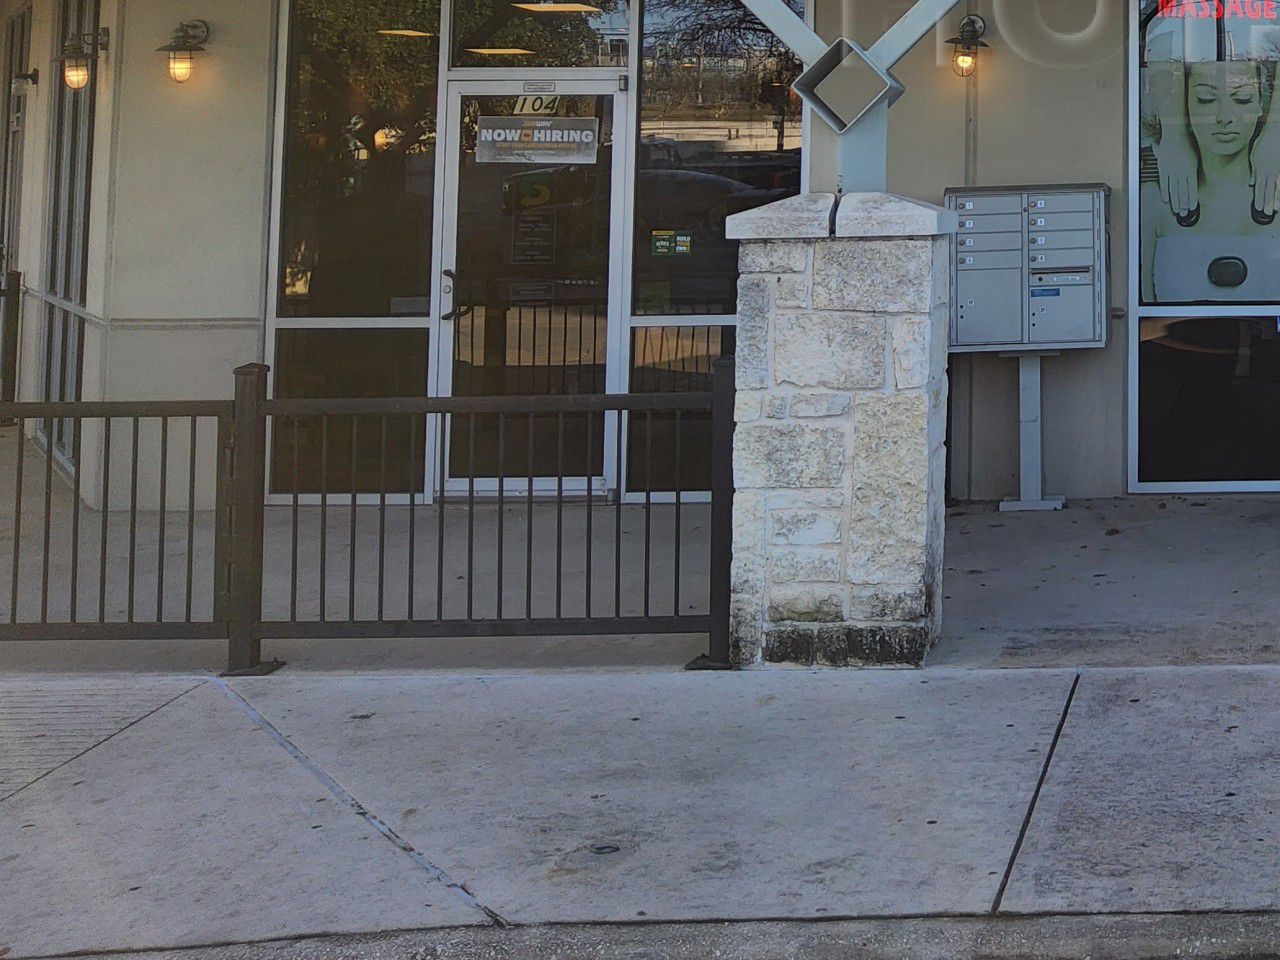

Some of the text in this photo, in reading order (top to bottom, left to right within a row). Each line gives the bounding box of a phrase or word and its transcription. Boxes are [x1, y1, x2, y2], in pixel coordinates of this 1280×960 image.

[520, 96, 557, 113] 104
[481, 128, 594, 143] NOW HIRING
